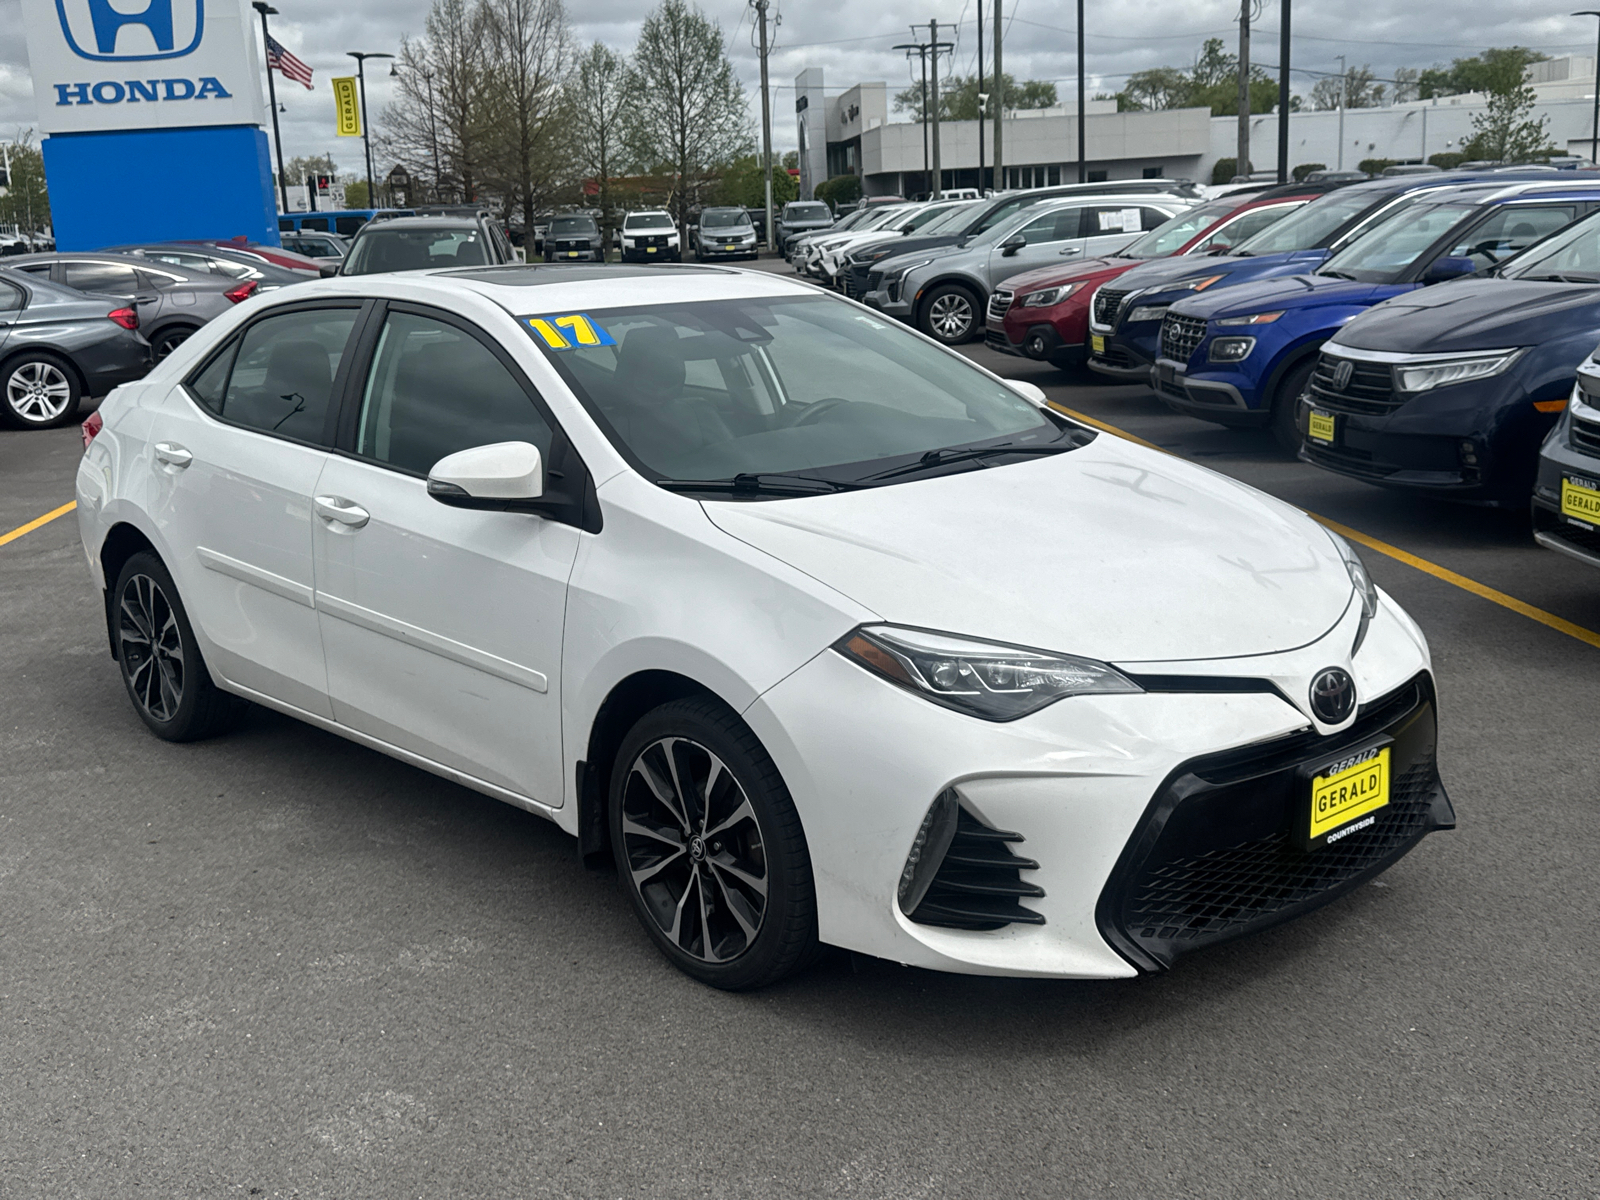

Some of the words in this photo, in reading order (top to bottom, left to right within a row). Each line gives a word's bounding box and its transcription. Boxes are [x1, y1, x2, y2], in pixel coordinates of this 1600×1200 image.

[53, 77, 233, 106] HONDA
[341, 85, 354, 130] GERALD
[331, 192, 345, 202] 35
[528, 314, 601, 348] 17
[1567, 494, 1600, 513] GERALD
[1328, 747, 1378, 777] GERALD
[1318, 774, 1377, 813] GERALD
[1326, 816, 1375, 844] COUNTRYSIDE
